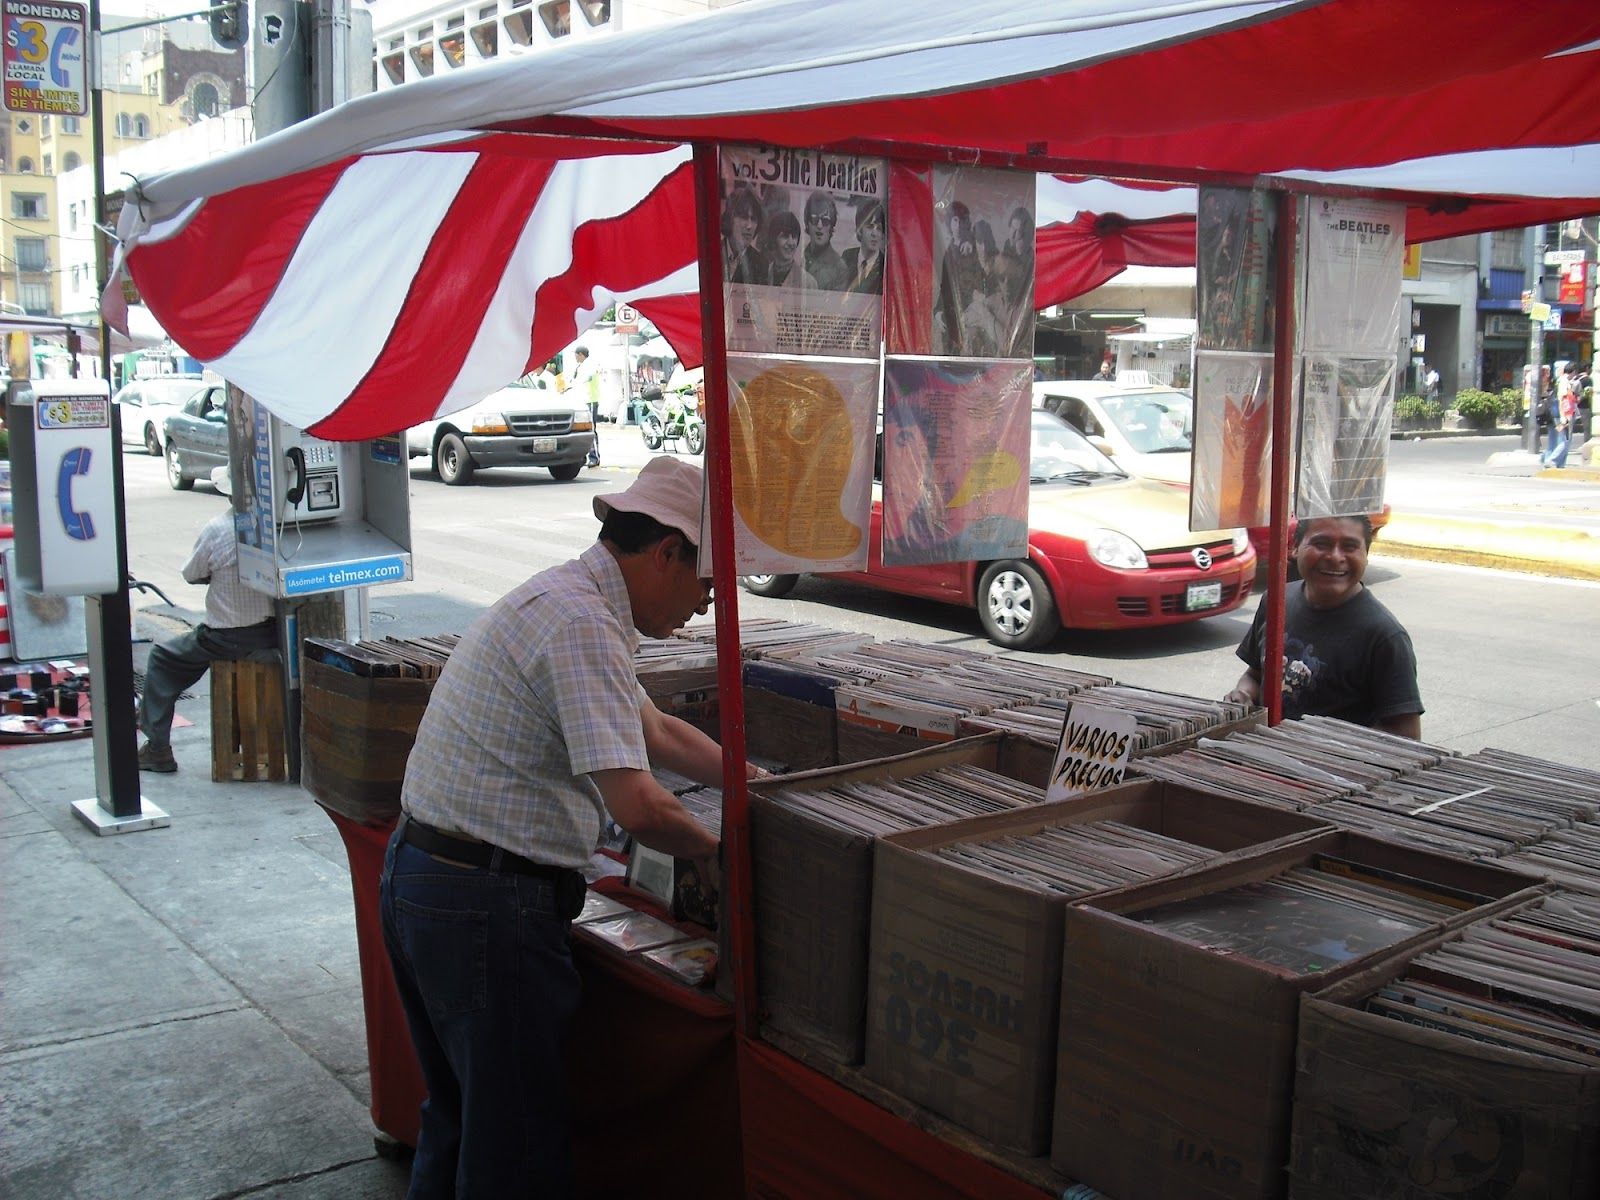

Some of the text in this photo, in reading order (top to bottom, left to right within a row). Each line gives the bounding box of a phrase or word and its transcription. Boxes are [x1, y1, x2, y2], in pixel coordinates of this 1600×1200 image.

[6, 2, 81, 20] MONEDAS
[7, 72, 45, 81] LOCAL
[8, 64, 46, 73] LLAMADA
[10, 87, 79, 102] SIN LIMITE
[11, 99, 80, 114] DE TIEMPO
[732, 147, 878, 194] vol. 3 the beatles
[1339, 219, 1391, 235] BEATLES
[257, 404, 274, 547] infinitu
[328, 564, 401, 584] telmex.com
[1065, 721, 1130, 763] VARIOS
[1052, 756, 1123, 792] PRECIOS
[888, 951, 1025, 1033] HUEVOS
